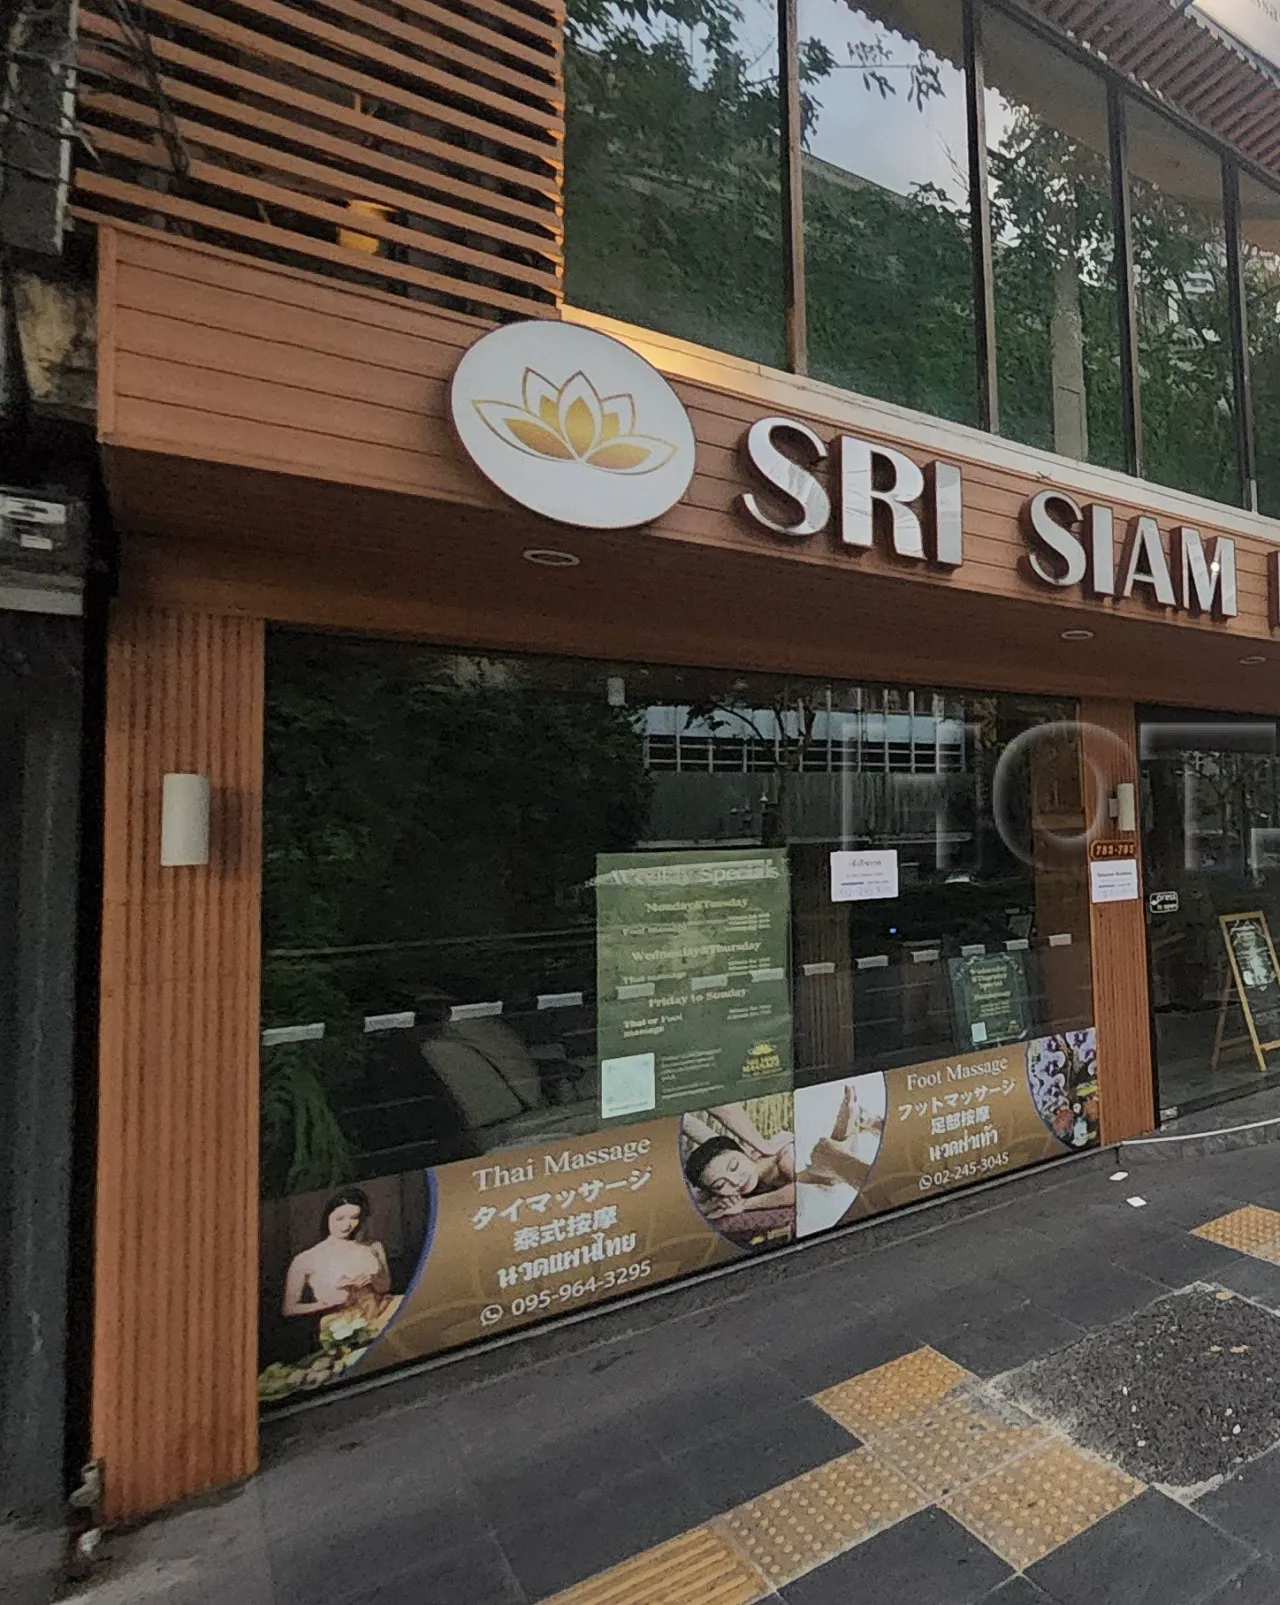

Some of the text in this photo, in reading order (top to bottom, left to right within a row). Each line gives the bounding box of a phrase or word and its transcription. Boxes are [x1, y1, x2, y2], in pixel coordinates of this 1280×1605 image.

[738, 415, 964, 567] SRI
[1025, 488, 1238, 619] SIAM
[648, 987, 748, 1009] Friday to Sunday
[907, 1057, 1009, 1091] Foot Massage
[898, 1077, 1017, 1121] フットマッサージ
[931, 1105, 991, 1136] 足部按摩
[472, 1138, 652, 1192] Thai Massage
[933, 1151, 1010, 1185] 02-245-3045
[472, 1165, 653, 1230] タイマッサージ
[513, 1204, 618, 1252] 泰式按摩
[498, 1232, 637, 1289] นวดแผนไทย
[511, 1259, 652, 1316] 095-964-3295
